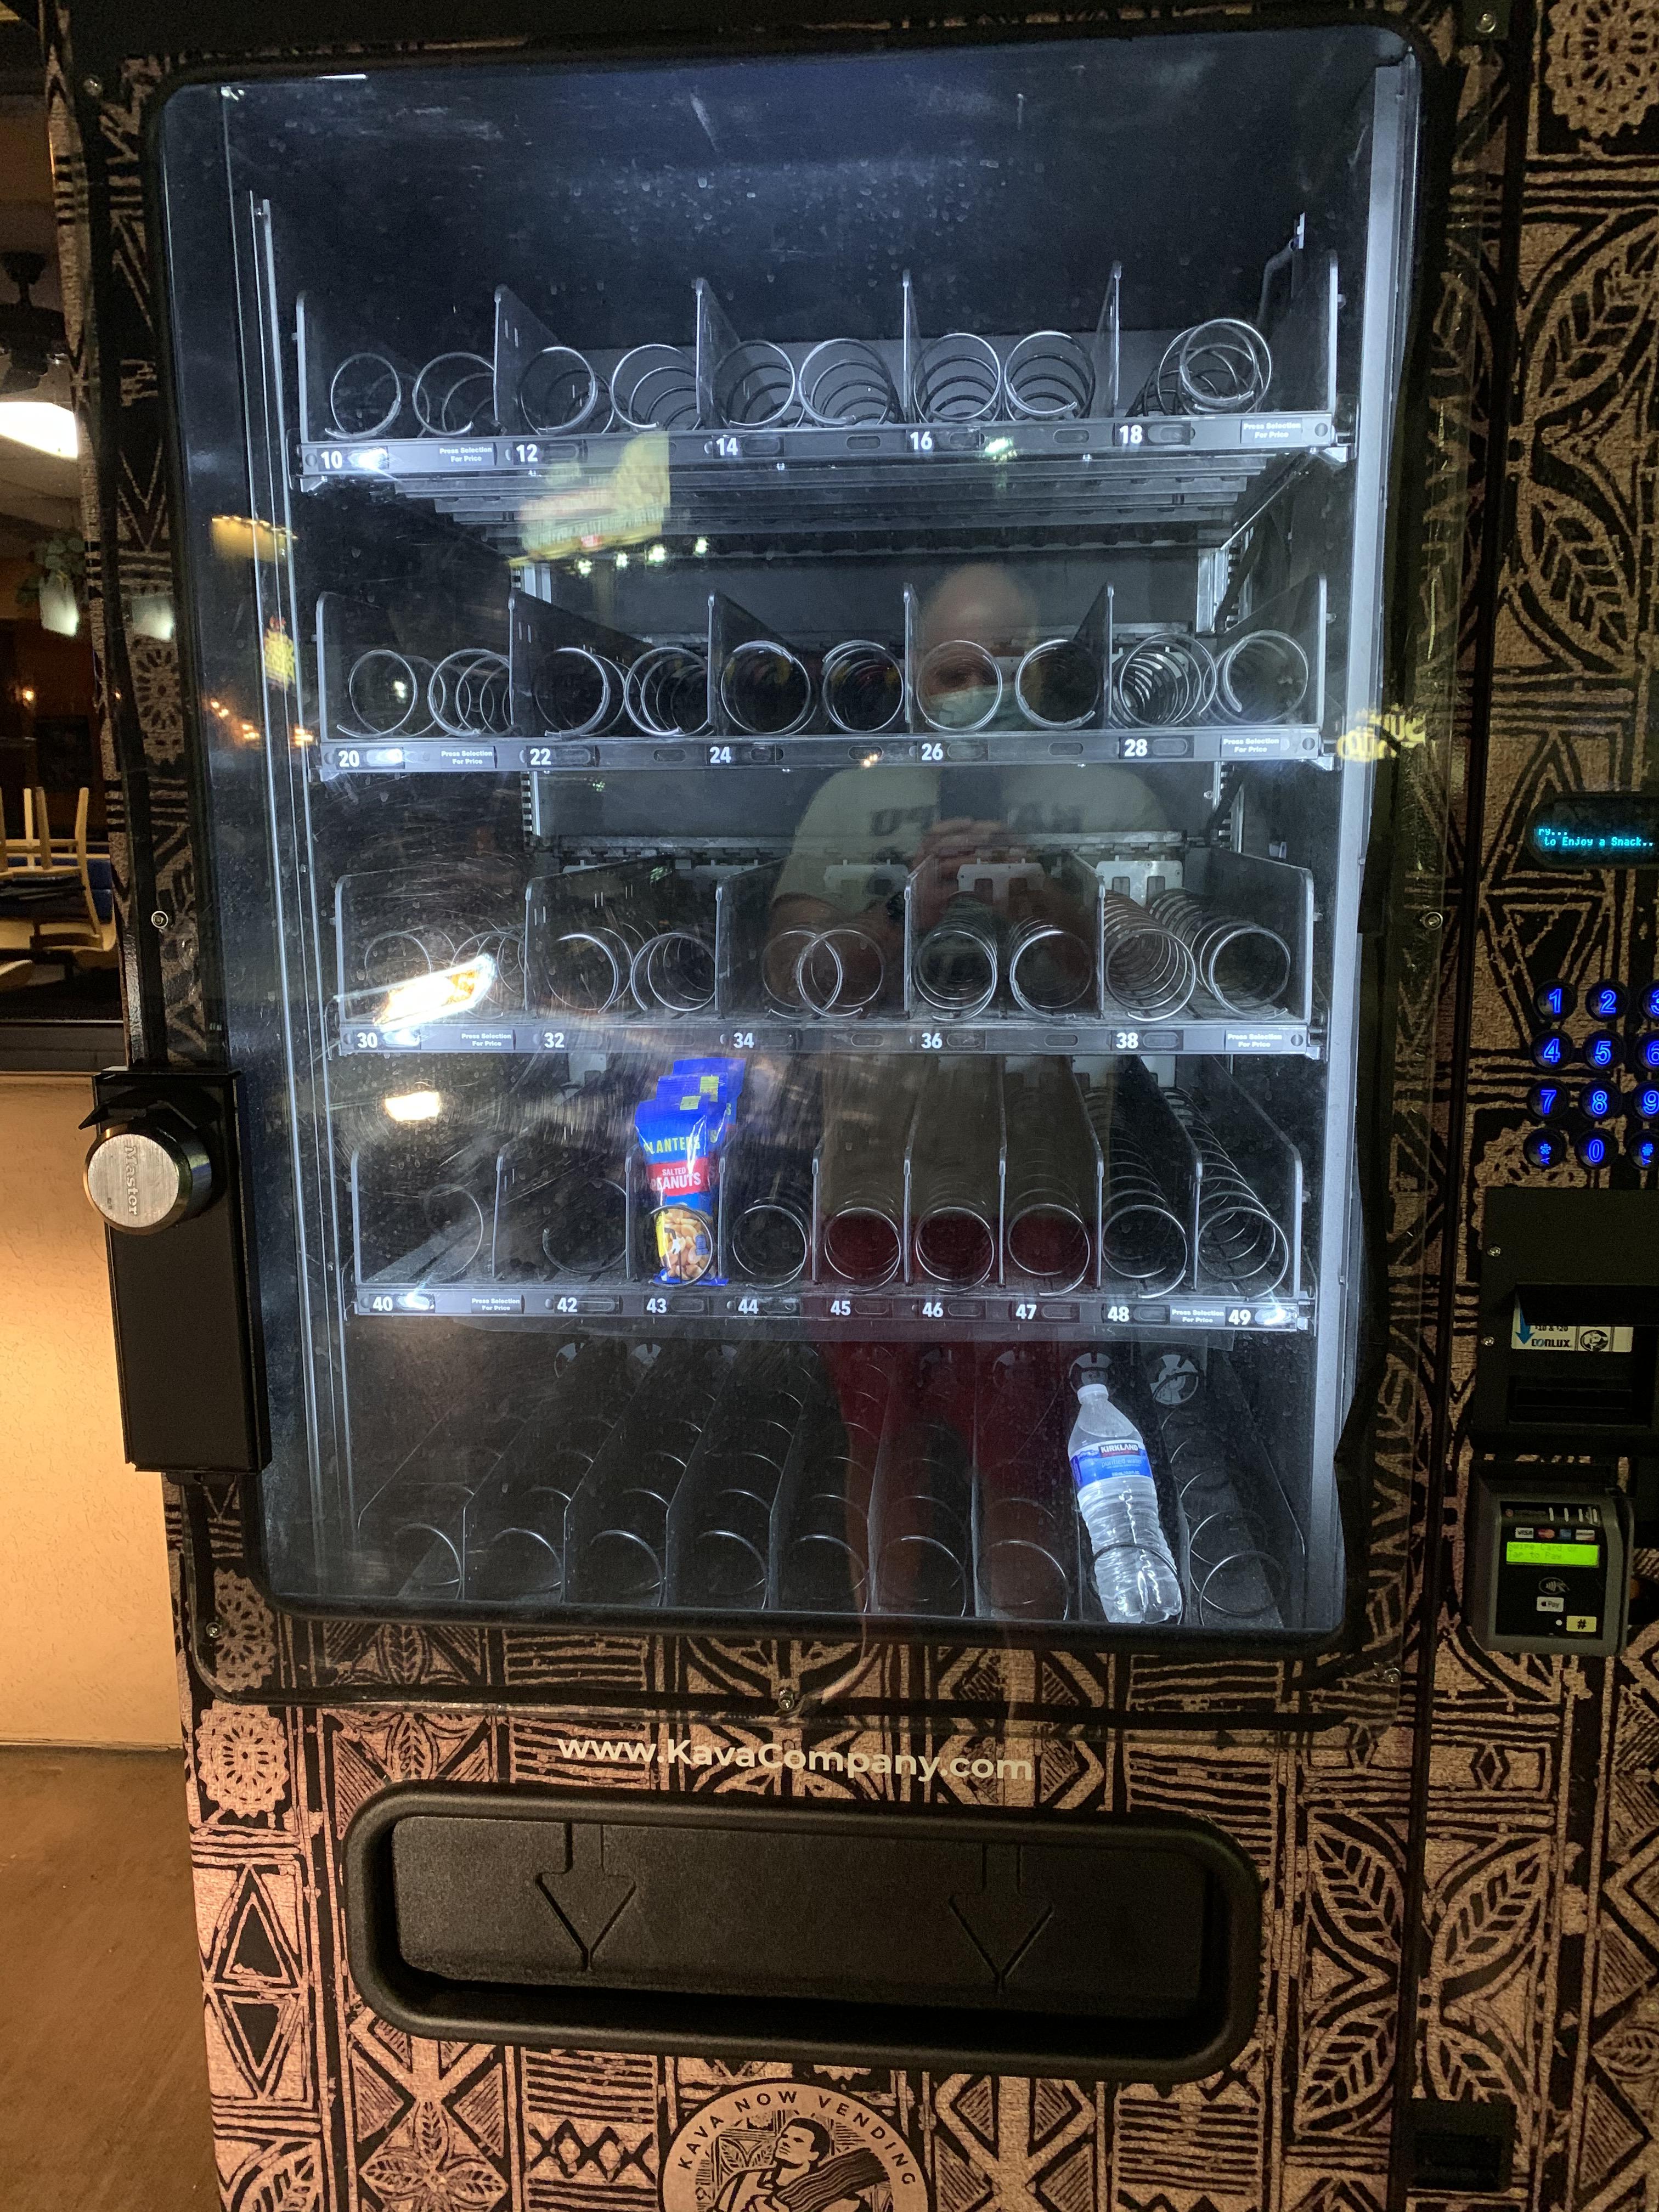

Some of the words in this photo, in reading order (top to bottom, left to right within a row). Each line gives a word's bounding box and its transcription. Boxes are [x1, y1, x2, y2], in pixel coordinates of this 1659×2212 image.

[910, 431, 932, 450] 16
[1120, 425, 1142, 443] 18
[516, 444, 538, 462] 12
[716, 438, 738, 455] 14
[321, 451, 342, 469] 10
[709, 747, 731, 763] 24
[921, 743, 943, 760] 26
[1125, 739, 1148, 757] 28
[338, 751, 359, 767] 20
[530, 748, 551, 765] 22
[1544, 837, 1556, 846] to
[1562, 837, 1593, 847] Enjoy
[1549, 989, 1562, 1013] 1
[1600, 990, 1616, 1013] 2
[357, 1032, 378, 1048] 30
[544, 1032, 565, 1048] 32
[733, 1032, 754, 1049] 34
[921, 1033, 942, 1049] 36
[1116, 1032, 1138, 1048] 38
[1544, 1039, 1560, 1062] 4
[1595, 1041, 1611, 1065] 5
[1647, 1041, 1659, 1065] 6
[1541, 1090, 1556, 1114] 7
[1592, 1091, 1607, 1114] 8
[1643, 1090, 1659, 1114] 9
[1589, 1139, 1604, 1163] 0
[662, 1167, 686, 1176] SALTED
[125, 1146, 138, 1215] Master
[650, 1172, 701, 1191] PEANUTS
[373, 1296, 393, 1312] 40
[557, 1297, 578, 1313] 42
[646, 1298, 667, 1313] 43
[738, 1299, 759, 1314] 44
[830, 1300, 851, 1316] 45
[922, 1301, 944, 1317] 46
[1015, 1304, 1037, 1319] 47
[1107, 1306, 1130, 1322] 48
[1228, 1309, 1251, 1325] 49
[1101, 1444, 1138, 1453] KIRKLAND
[1102, 1459, 1125, 1468] purified
[1577, 1619, 1586, 1629] #
[557, 1738, 1032, 1781] www.KavaCompany.com
[678, 2115, 724, 2169] KAVA
[735, 2091, 797, 2113] NOW
[819, 2095, 916, 2184] VENDING
